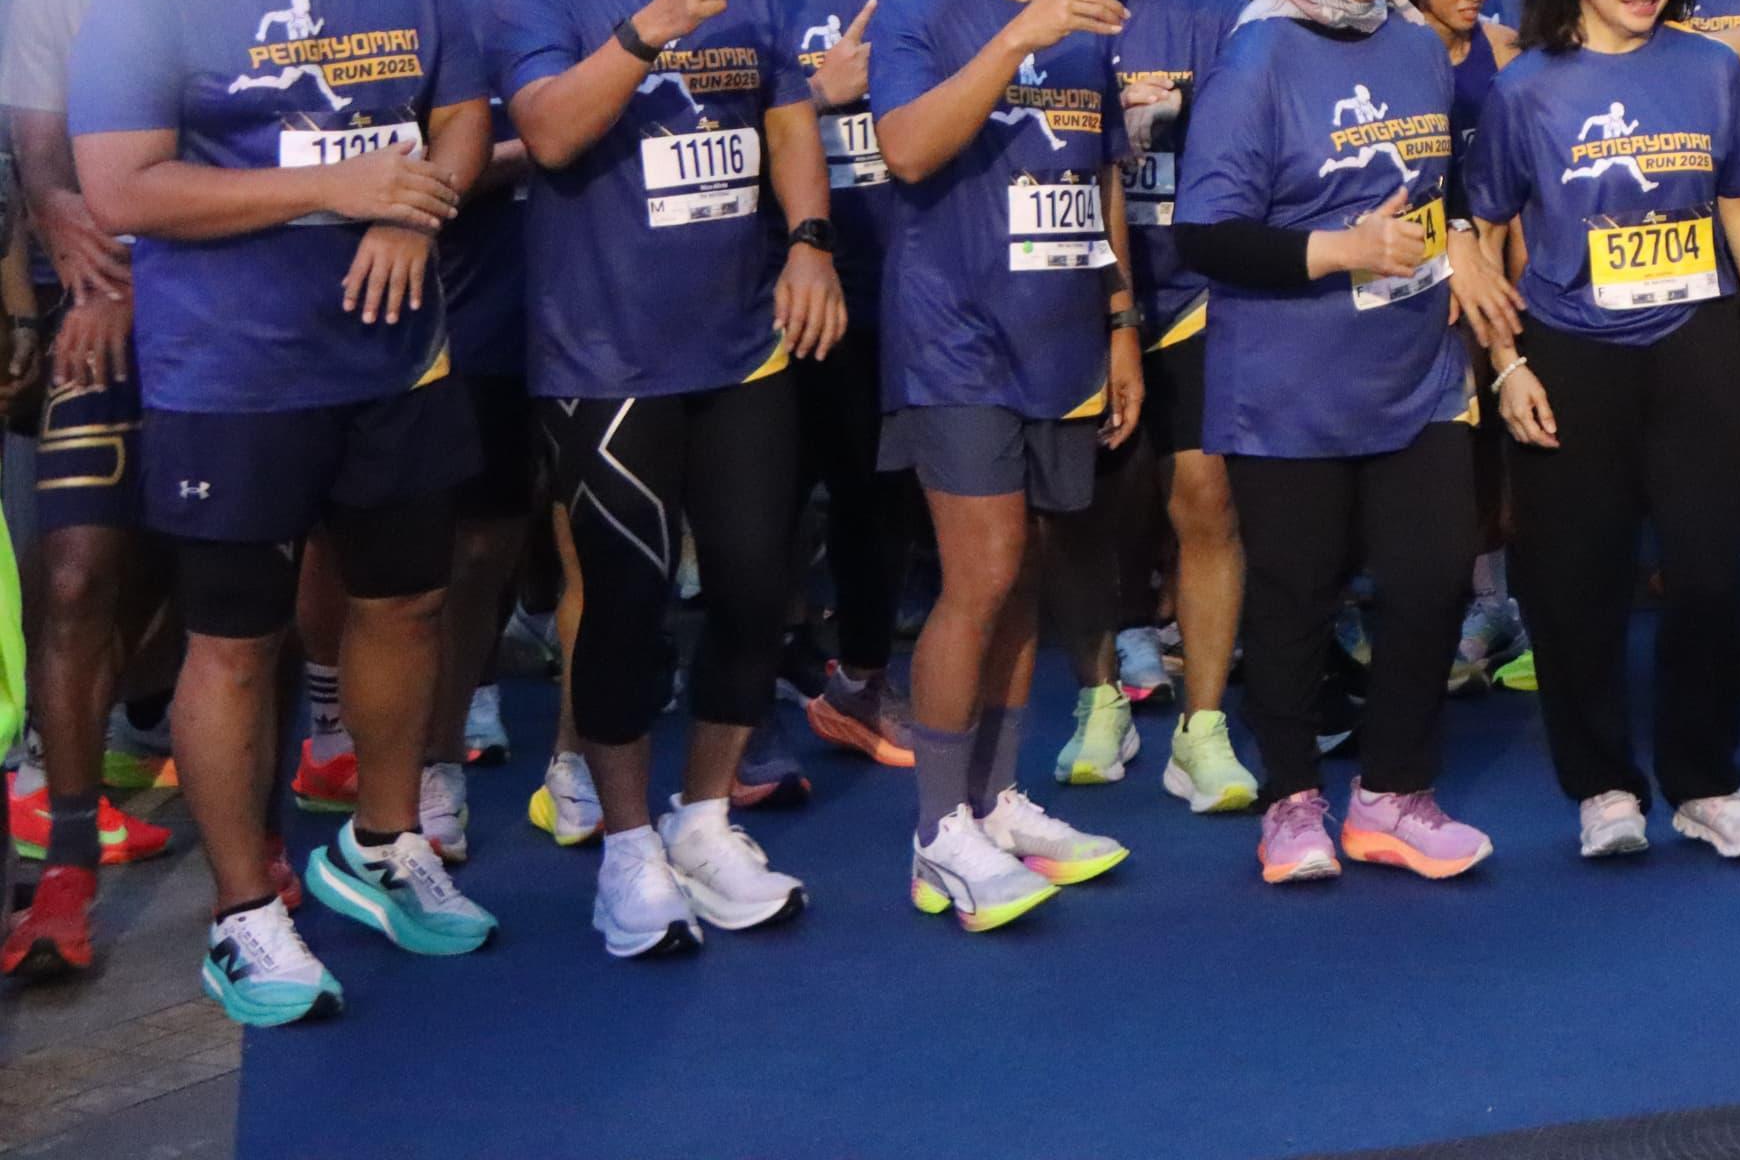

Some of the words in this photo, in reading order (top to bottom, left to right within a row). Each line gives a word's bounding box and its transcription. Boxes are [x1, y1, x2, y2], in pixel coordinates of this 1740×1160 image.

[248, 29, 419, 69] PENGAYOMAN
[651, 47, 759, 71] NGAYOMAN
[332, 63, 373, 82] RUN
[377, 58, 416, 74] 2025
[690, 76, 722, 90] RUN
[725, 73, 759, 87] 2025
[1053, 114, 1081, 127] RUN
[670, 134, 744, 180] 11116
[1406, 143, 1435, 156] RUN
[1572, 132, 1712, 163] PENGAYOMAN
[1645, 155, 1677, 169] RUN
[1680, 154, 1710, 168] 2025
[651, 200, 665, 213] M
[1030, 190, 1096, 228] 11204
[1607, 224, 1700, 270] 52704
